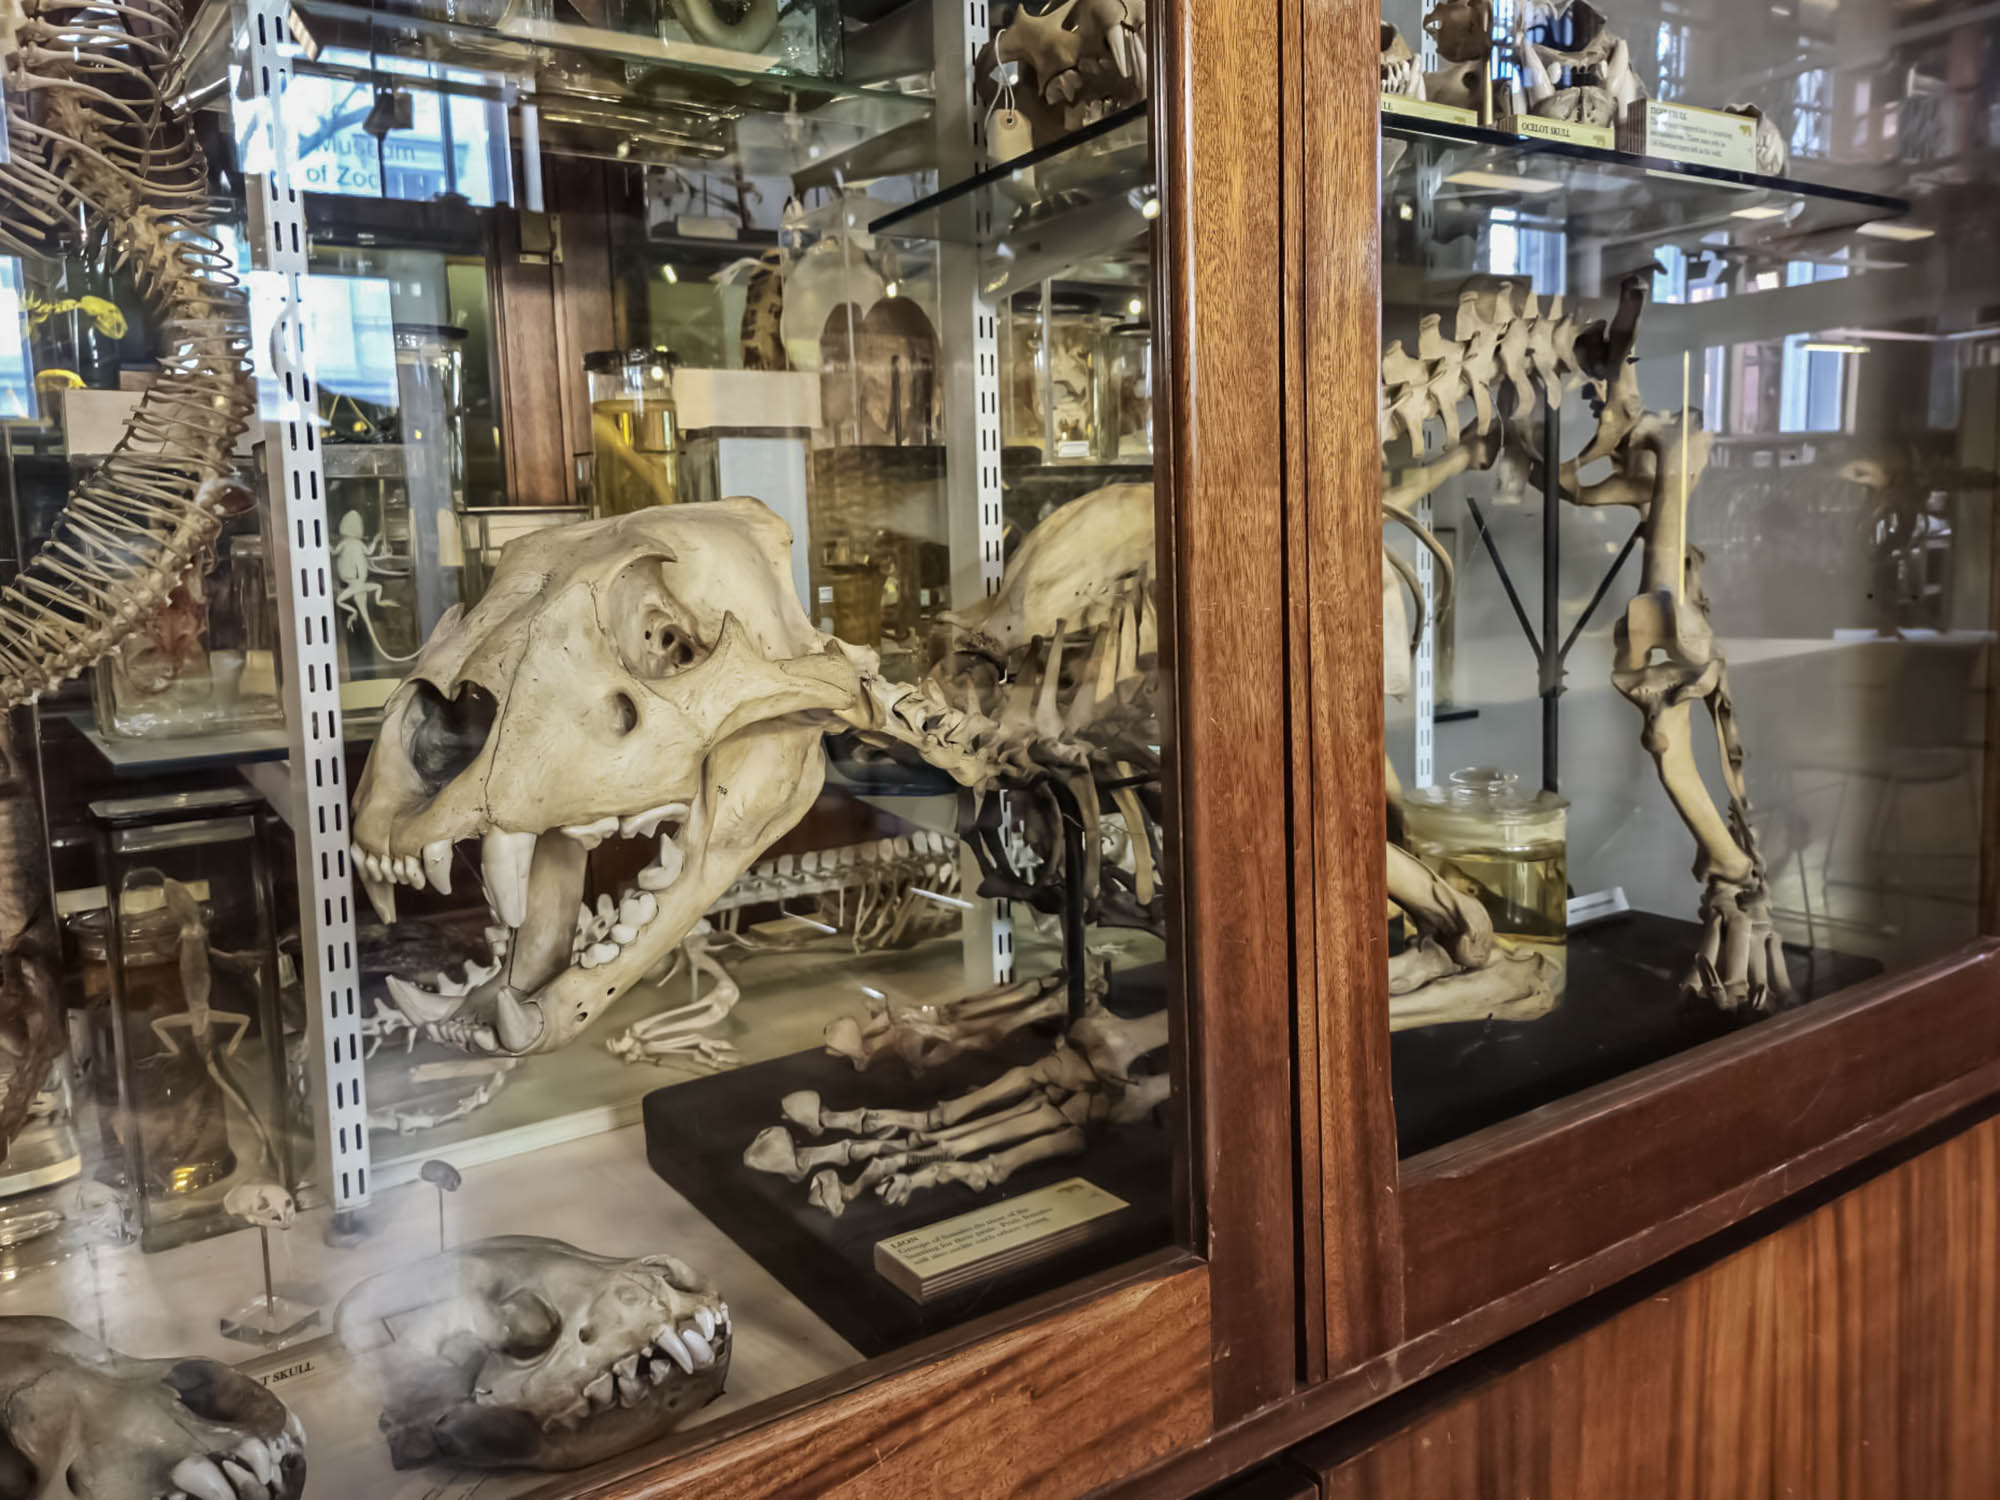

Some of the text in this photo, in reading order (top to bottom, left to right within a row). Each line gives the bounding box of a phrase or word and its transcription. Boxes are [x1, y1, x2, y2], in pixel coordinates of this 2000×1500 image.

[1521, 121, 1572, 139] OCELOT SKULL
[306, 164, 327, 183] of
[890, 1235, 920, 1250] LION
[273, 1362, 315, 1383] SKULL
